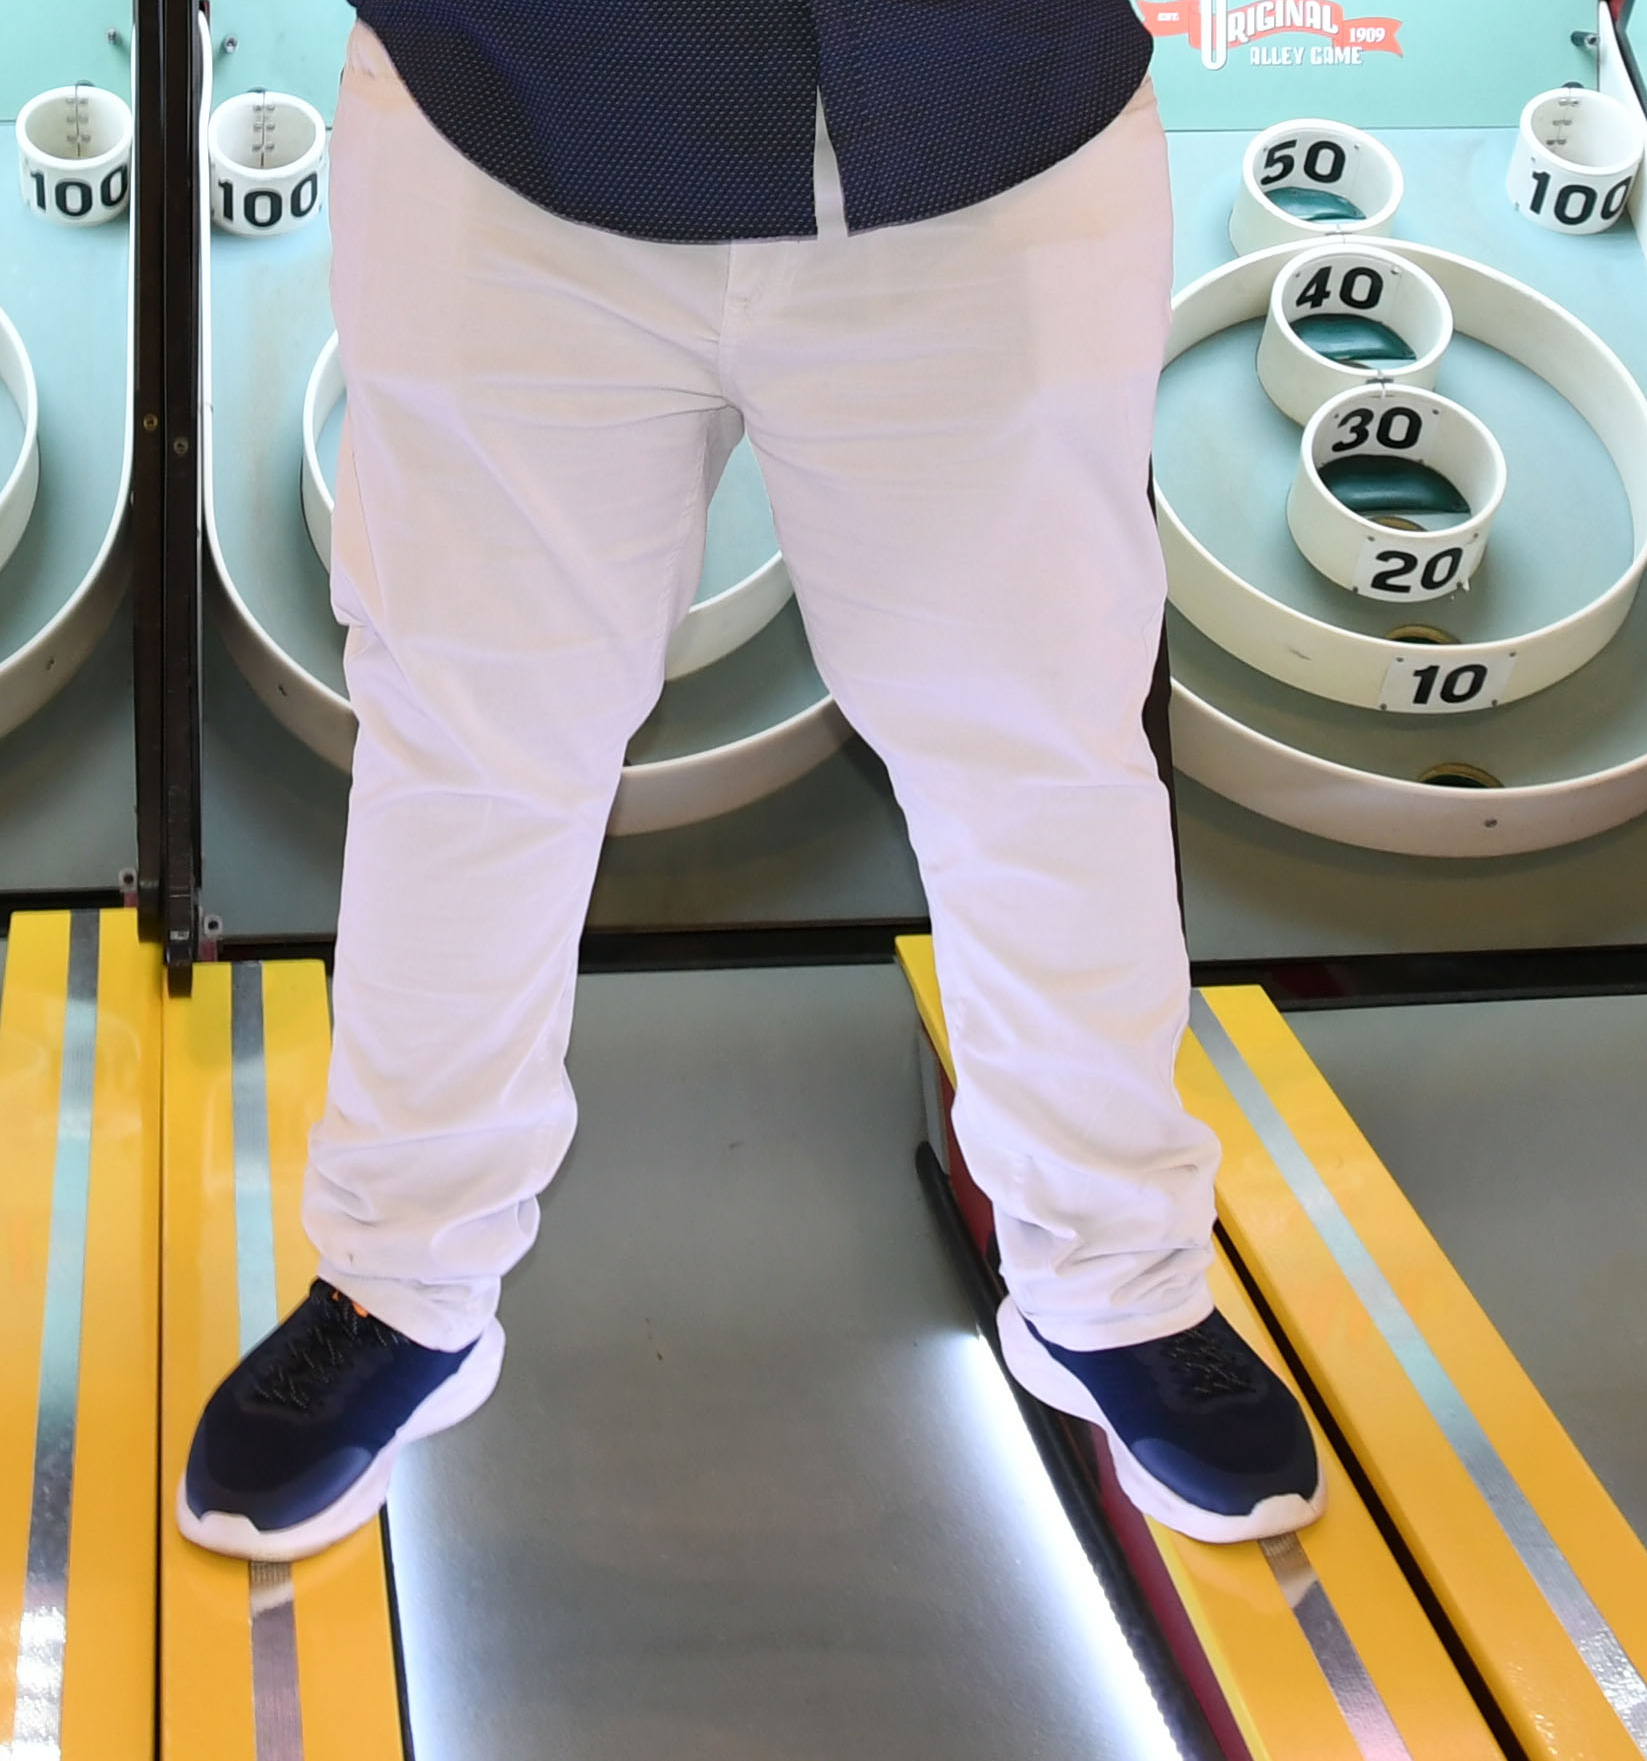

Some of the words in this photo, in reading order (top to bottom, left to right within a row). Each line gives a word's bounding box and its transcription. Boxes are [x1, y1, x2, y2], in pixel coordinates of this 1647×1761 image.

[1250, 47, 1305, 66] ALLEY
[1310, 47, 1363, 66] GAME
[1349, 27, 1386, 44] 1909
[1260, 140, 1346, 186] 50
[30, 163, 129, 218] 100
[217, 171, 318, 228] 100
[1529, 171, 1632, 226] 100
[1295, 266, 1384, 310] 40
[1330, 405, 1422, 453] 30
[1370, 546, 1463, 594] 20
[1411, 663, 1488, 705] 10
